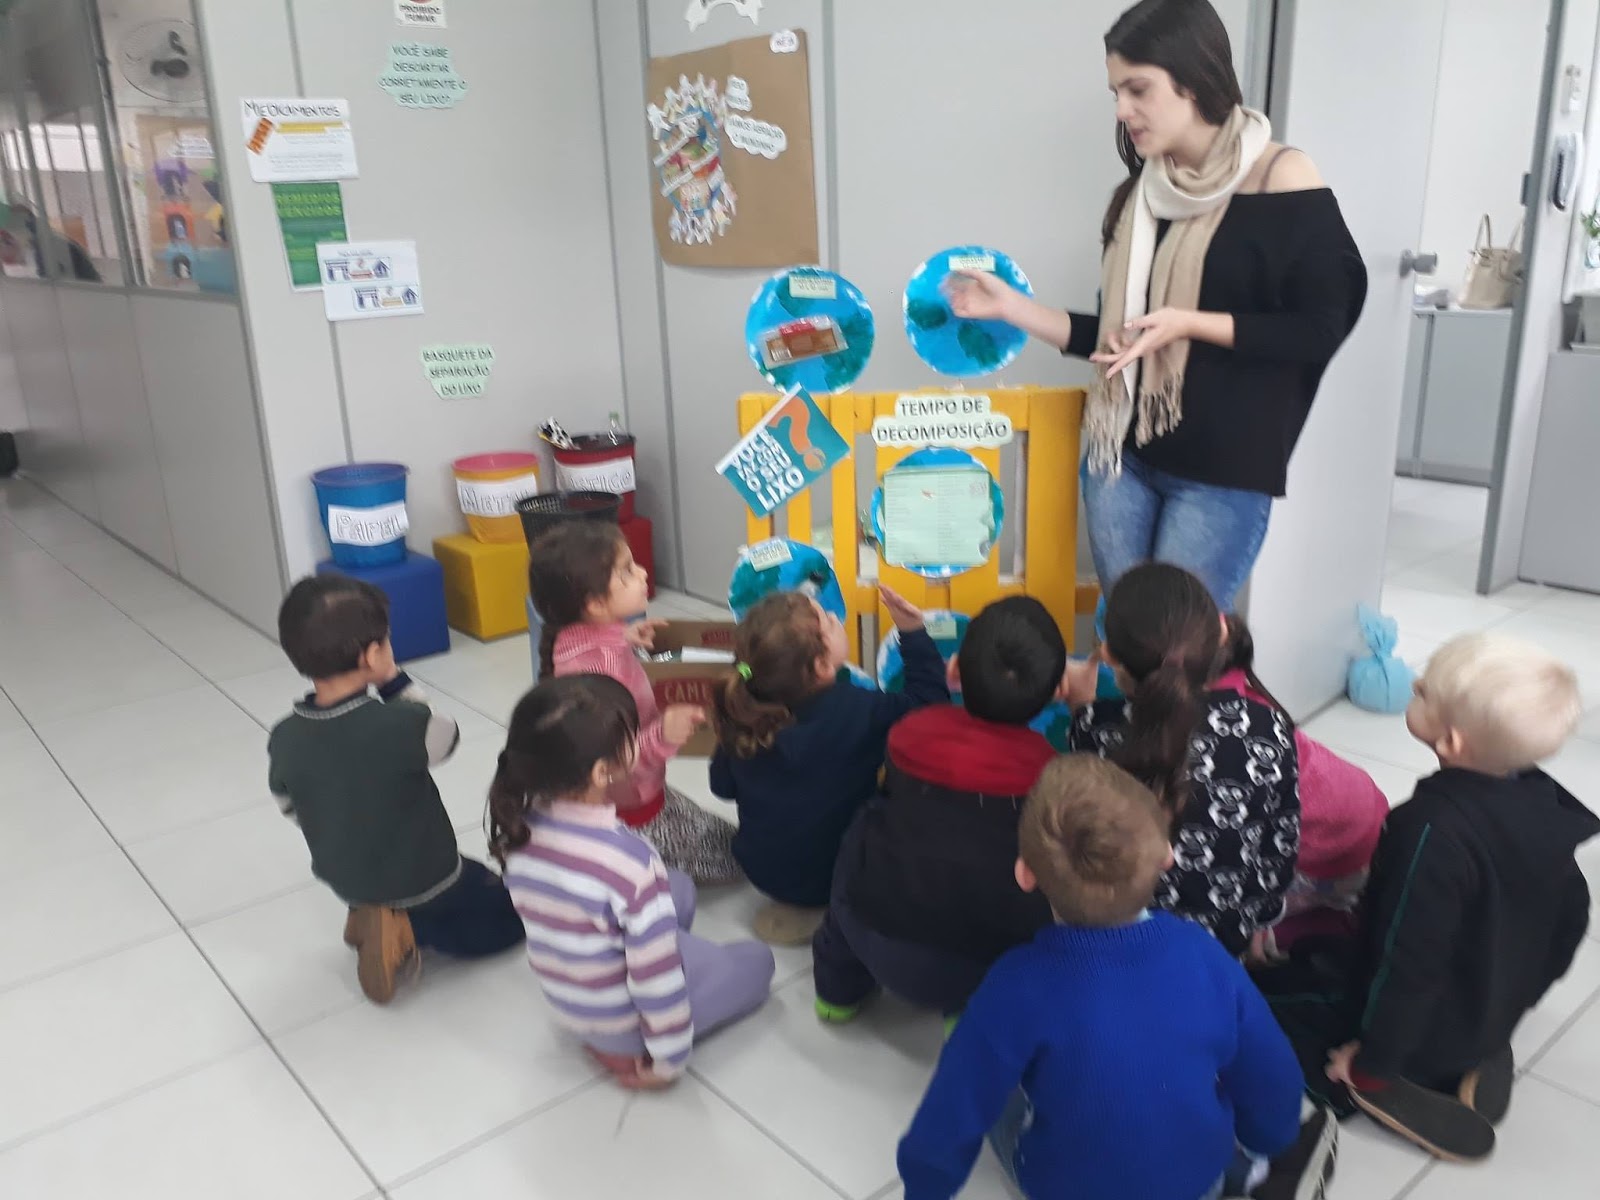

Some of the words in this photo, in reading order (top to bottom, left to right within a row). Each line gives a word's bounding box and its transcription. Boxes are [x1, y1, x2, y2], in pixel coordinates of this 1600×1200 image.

[900, 399, 957, 416] TEMPO
[961, 399, 984, 413] DE
[876, 420, 1008, 441] DECOMPOSIÇÃO
[756, 466, 805, 511] LIXO
